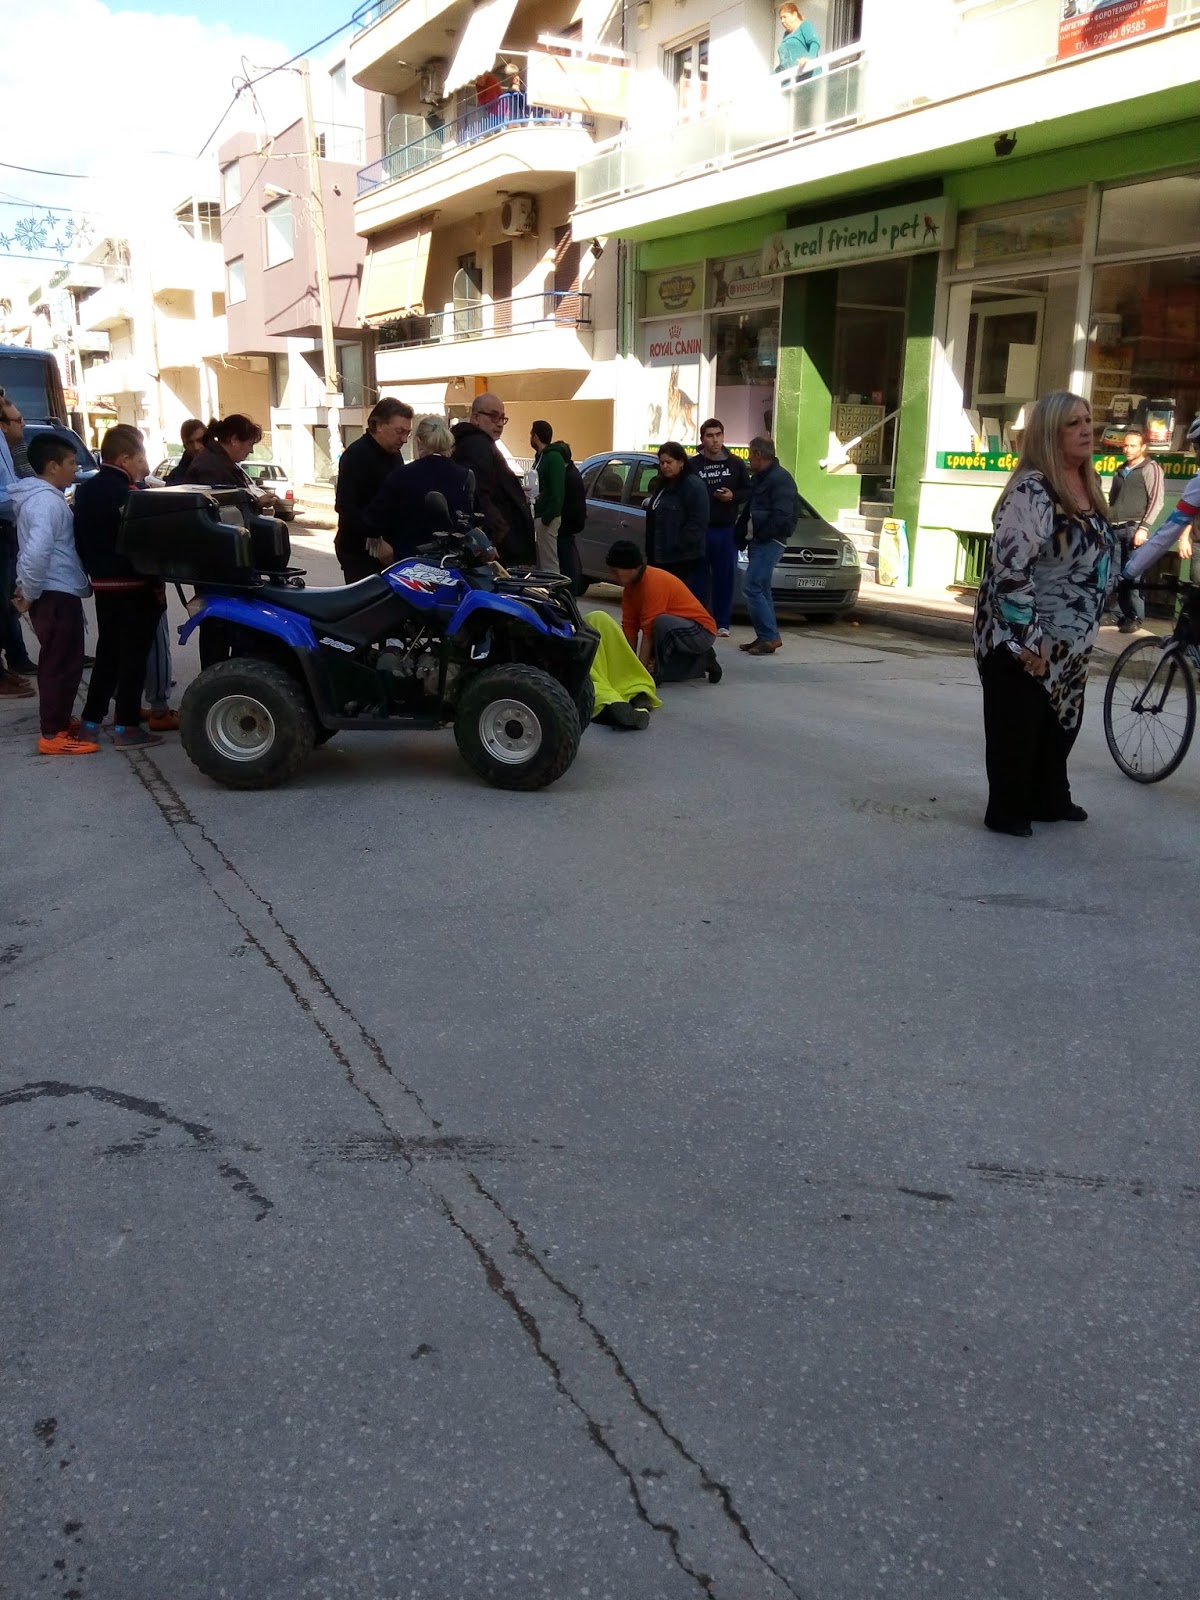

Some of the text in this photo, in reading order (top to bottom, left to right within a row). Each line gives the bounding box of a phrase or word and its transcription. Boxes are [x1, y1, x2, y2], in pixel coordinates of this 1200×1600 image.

[1093, 27, 1119, 45] 22940
[1120, 19, 1147, 37] 89585
[793, 225, 824, 258] real
[649, 337, 702, 358] ROYAL CANIN
[946, 452, 986, 470] τροφές
